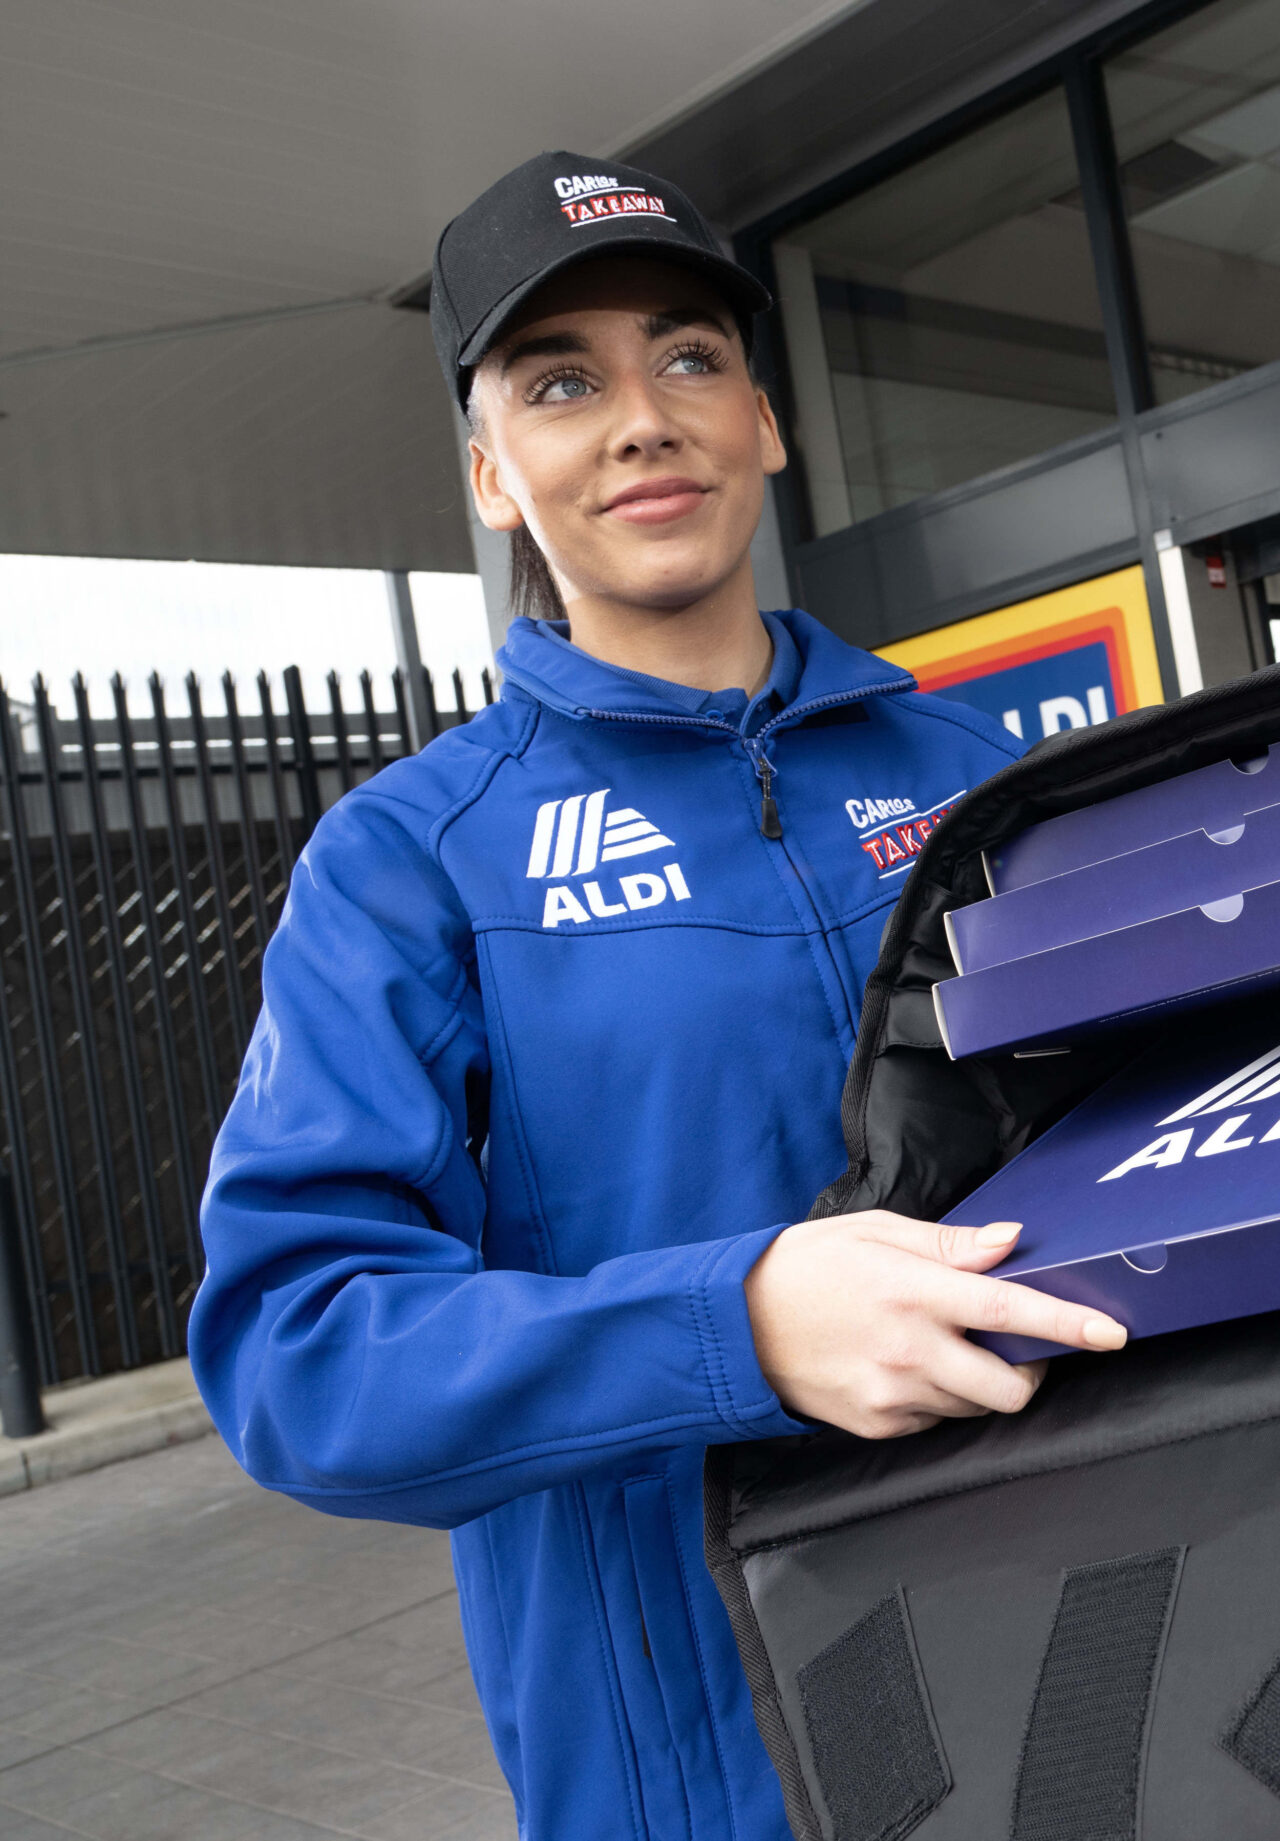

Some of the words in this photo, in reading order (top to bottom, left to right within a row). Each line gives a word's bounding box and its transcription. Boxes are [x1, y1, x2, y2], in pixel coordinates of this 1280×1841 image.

[561, 193, 666, 222] TAKEAWAY
[861, 804, 955, 870] TAKE
[542, 863, 691, 928] ALDI
